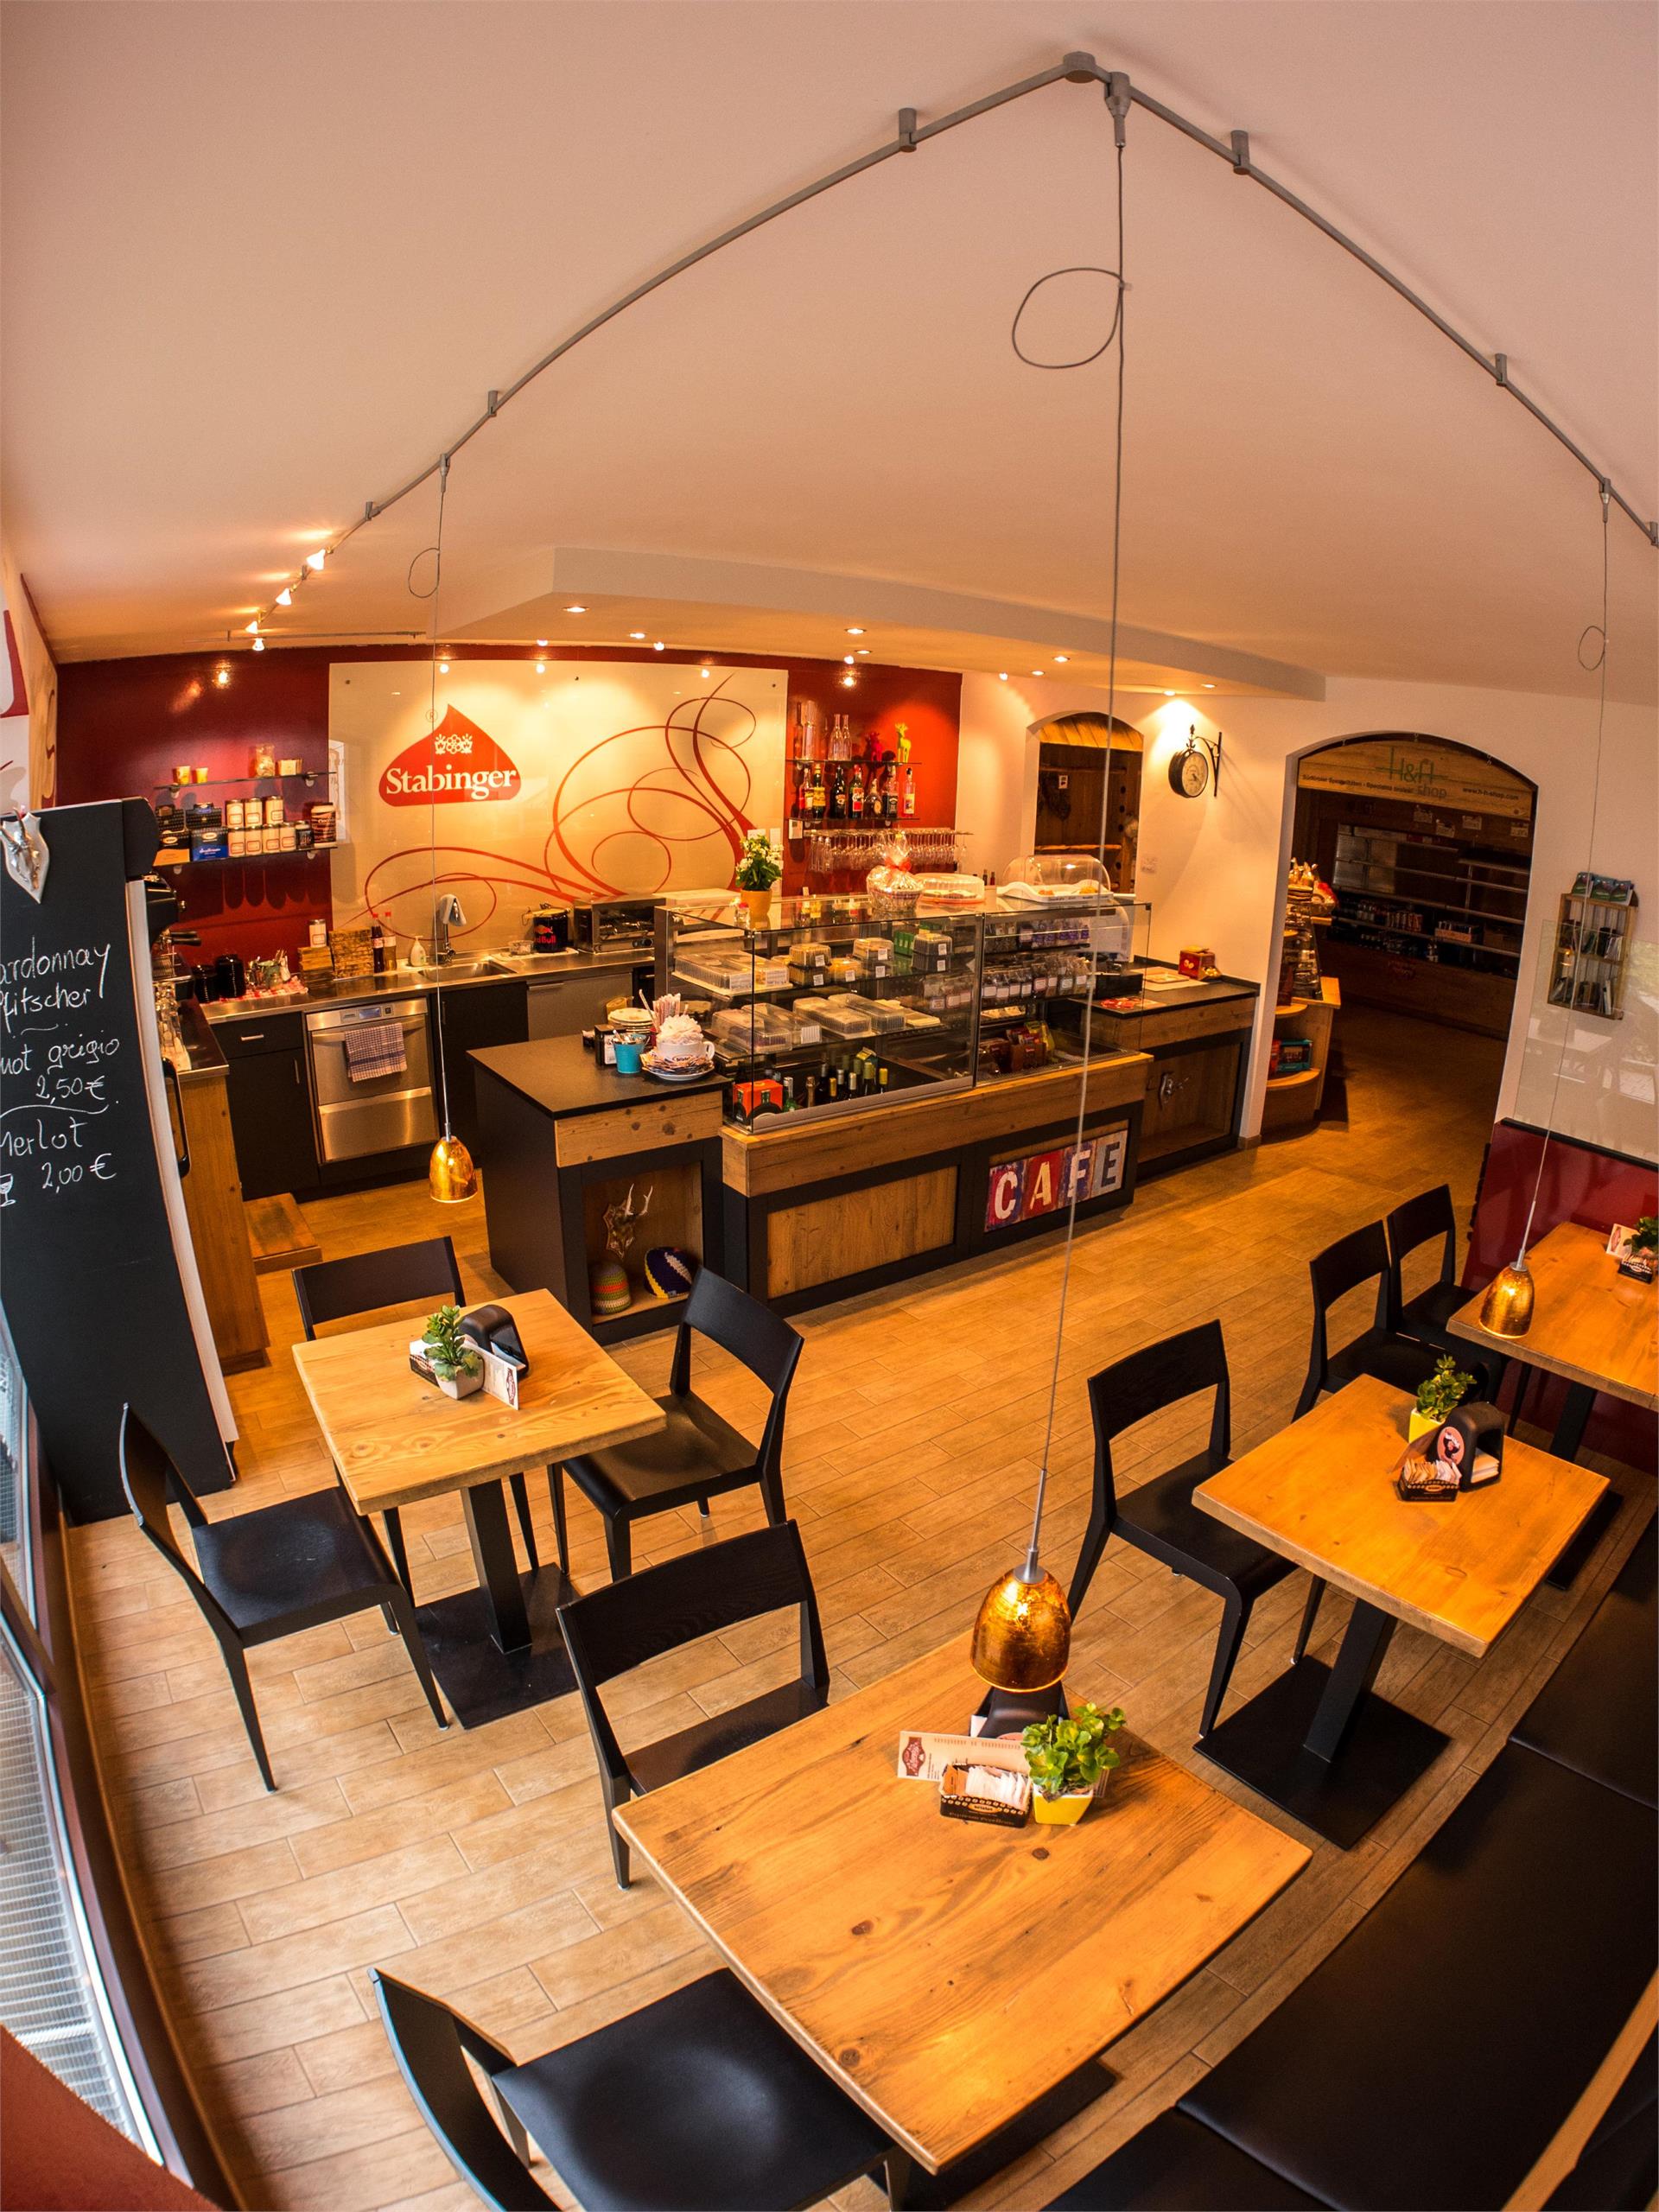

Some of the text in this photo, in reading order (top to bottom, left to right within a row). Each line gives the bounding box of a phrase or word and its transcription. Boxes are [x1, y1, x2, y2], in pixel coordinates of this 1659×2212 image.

[386, 764, 517, 800] Stabinger
[1416, 784, 1447, 799] shop
[47, 1030, 120, 1075] grigio
[995, 1141, 1121, 1220] CAFE
